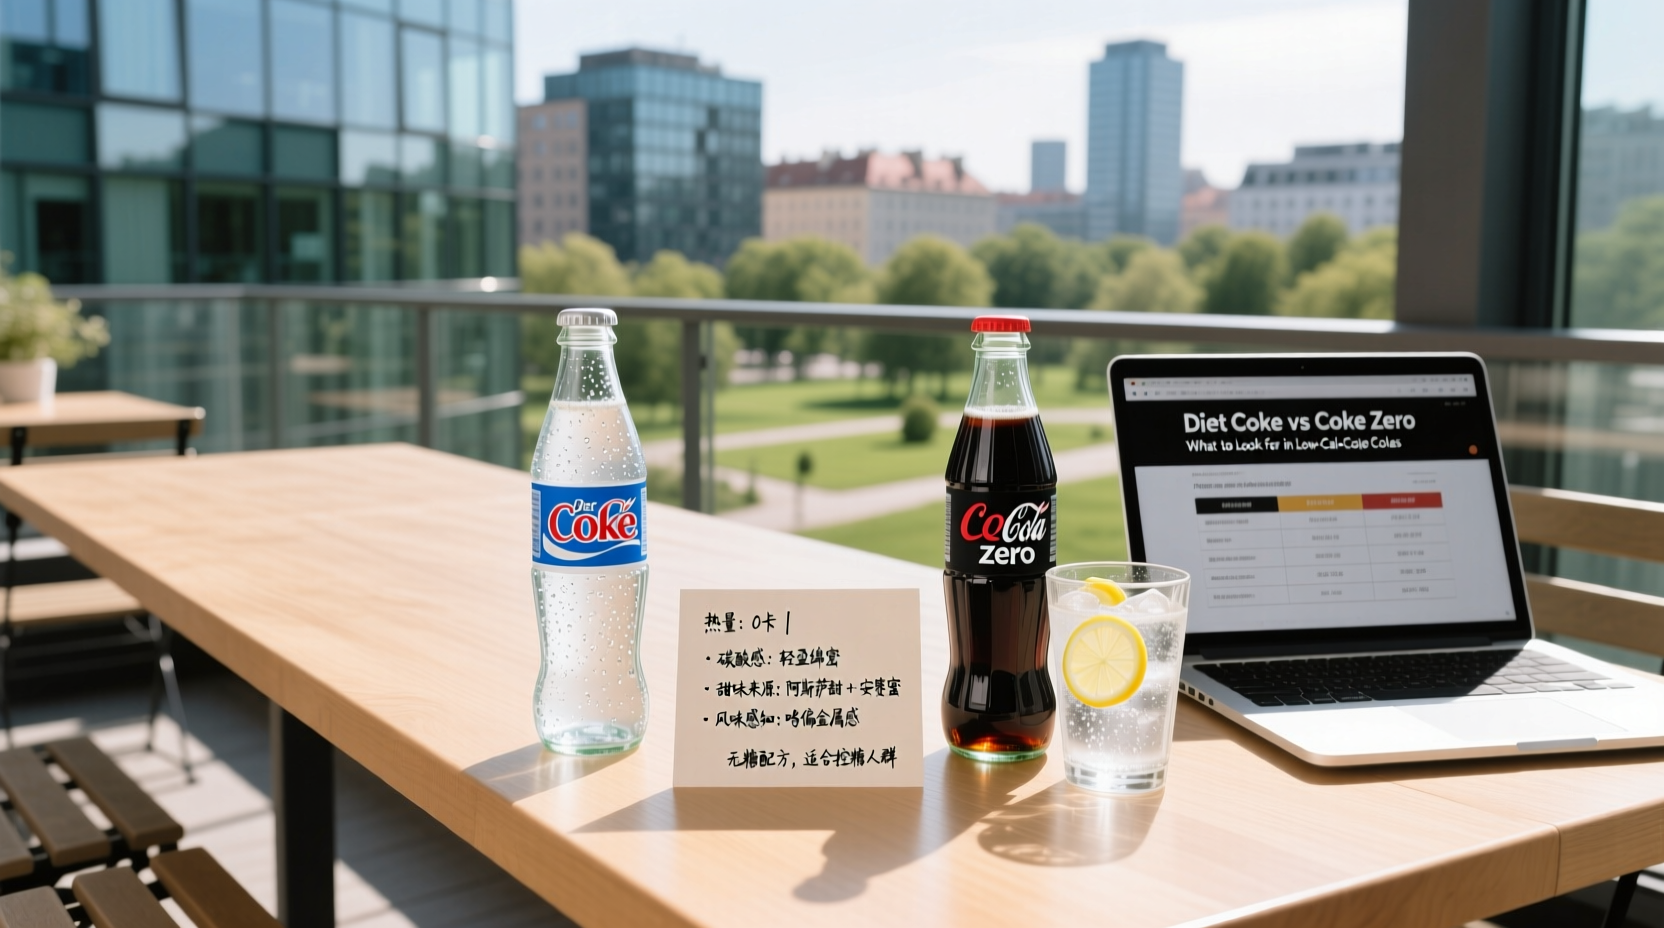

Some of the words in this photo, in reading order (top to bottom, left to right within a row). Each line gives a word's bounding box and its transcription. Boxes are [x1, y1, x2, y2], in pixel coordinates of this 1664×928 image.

[1183, 412, 1228, 433] Diet
[1231, 411, 1283, 432] Coke
[1287, 416, 1311, 431] vs
[1315, 410, 1367, 430] Coke
[1369, 410, 1416, 430] Zero
[1185, 439, 1218, 452] What
[1220, 440, 1233, 451] to
[1235, 437, 1263, 451] Look
[1283, 437, 1294, 450] in
[548, 498, 638, 543] Coke
